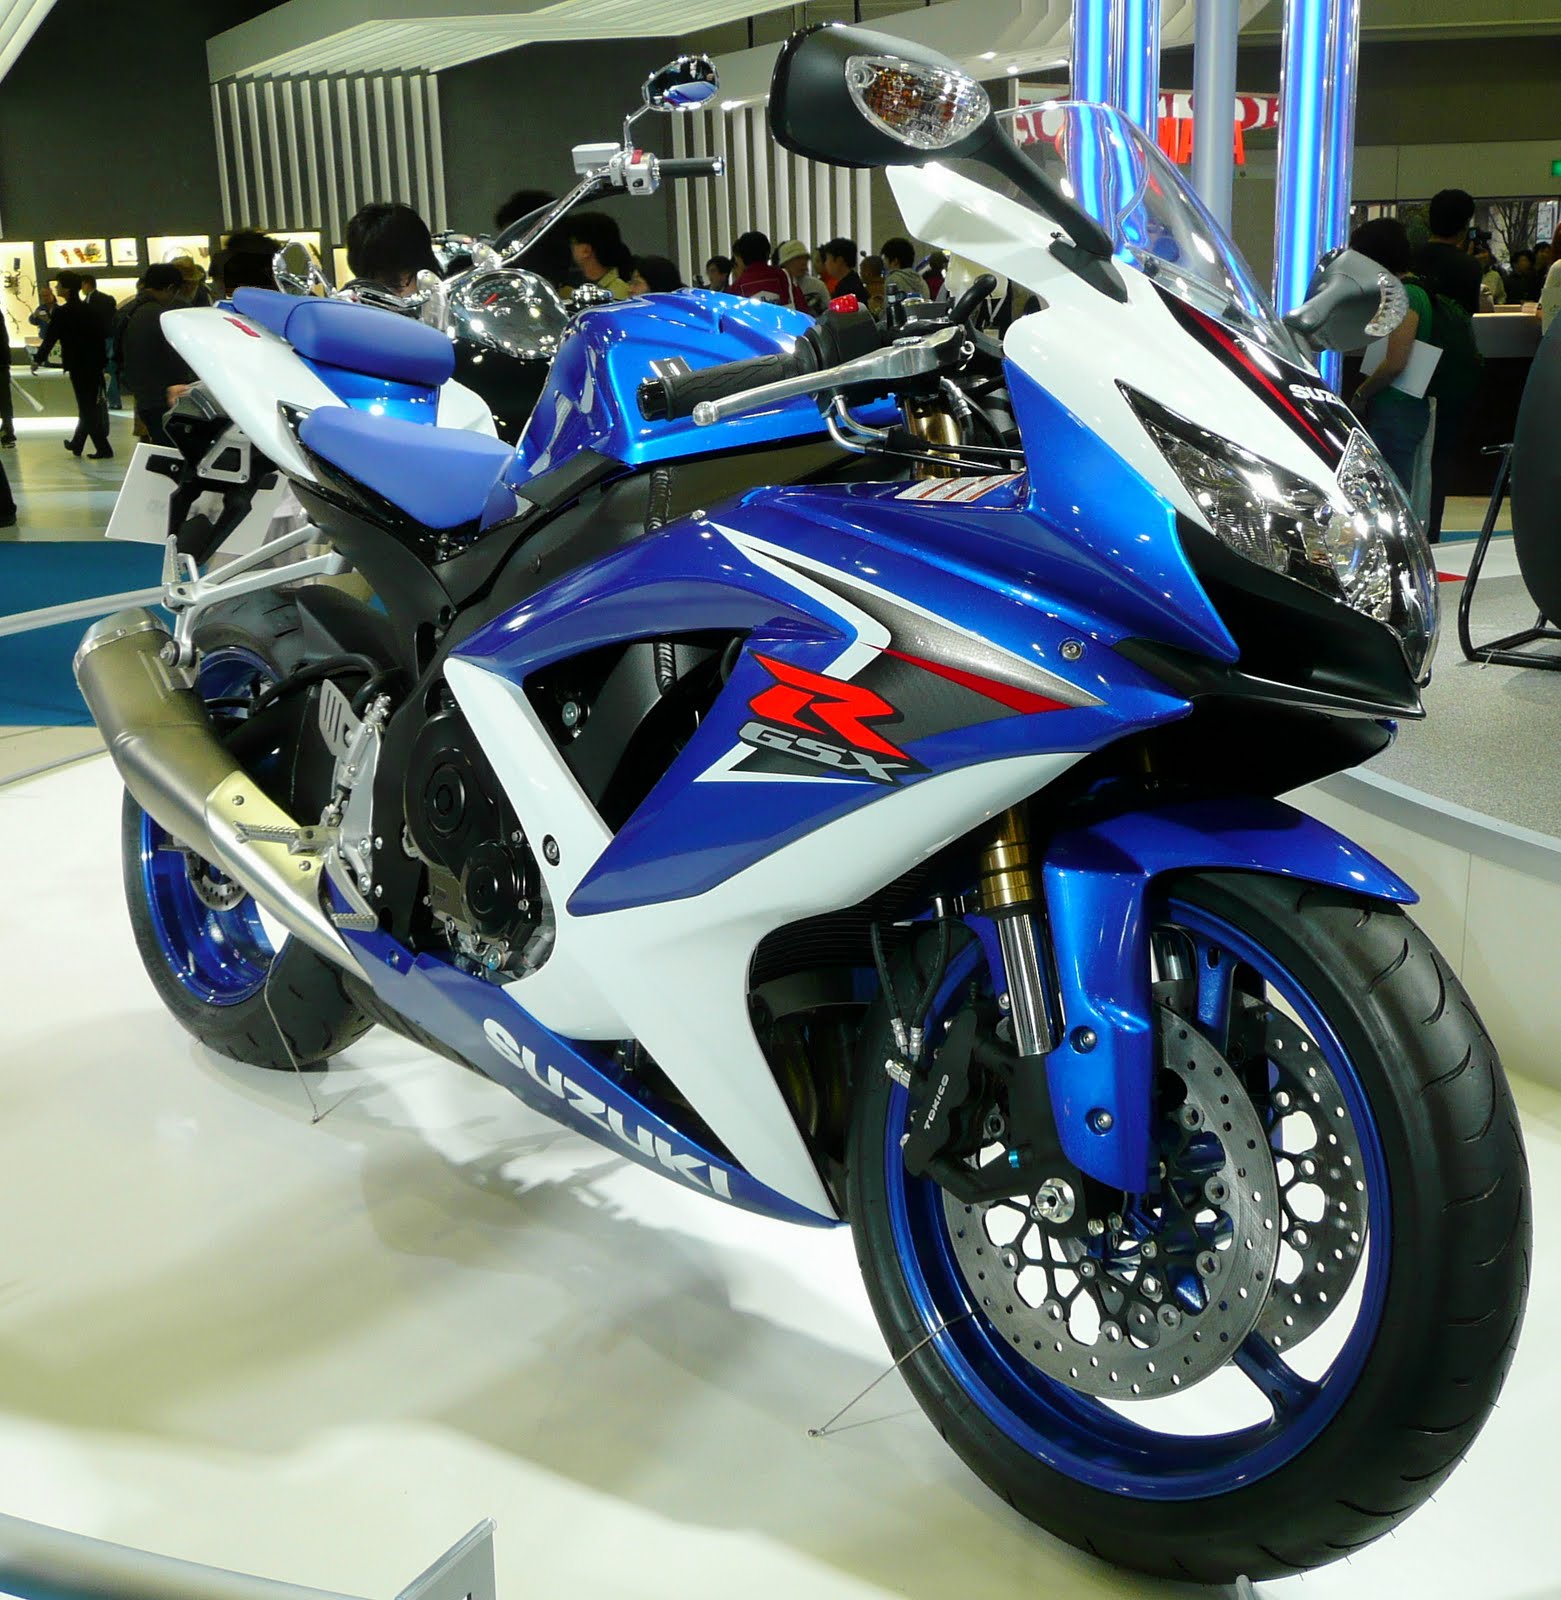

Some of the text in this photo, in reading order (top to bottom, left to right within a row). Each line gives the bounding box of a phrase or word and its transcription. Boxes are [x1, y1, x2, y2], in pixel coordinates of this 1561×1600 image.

[738, 721, 911, 782] GSX
[483, 1018, 732, 1200] SUZUKI
[923, 1074, 950, 1130] TOKICO
